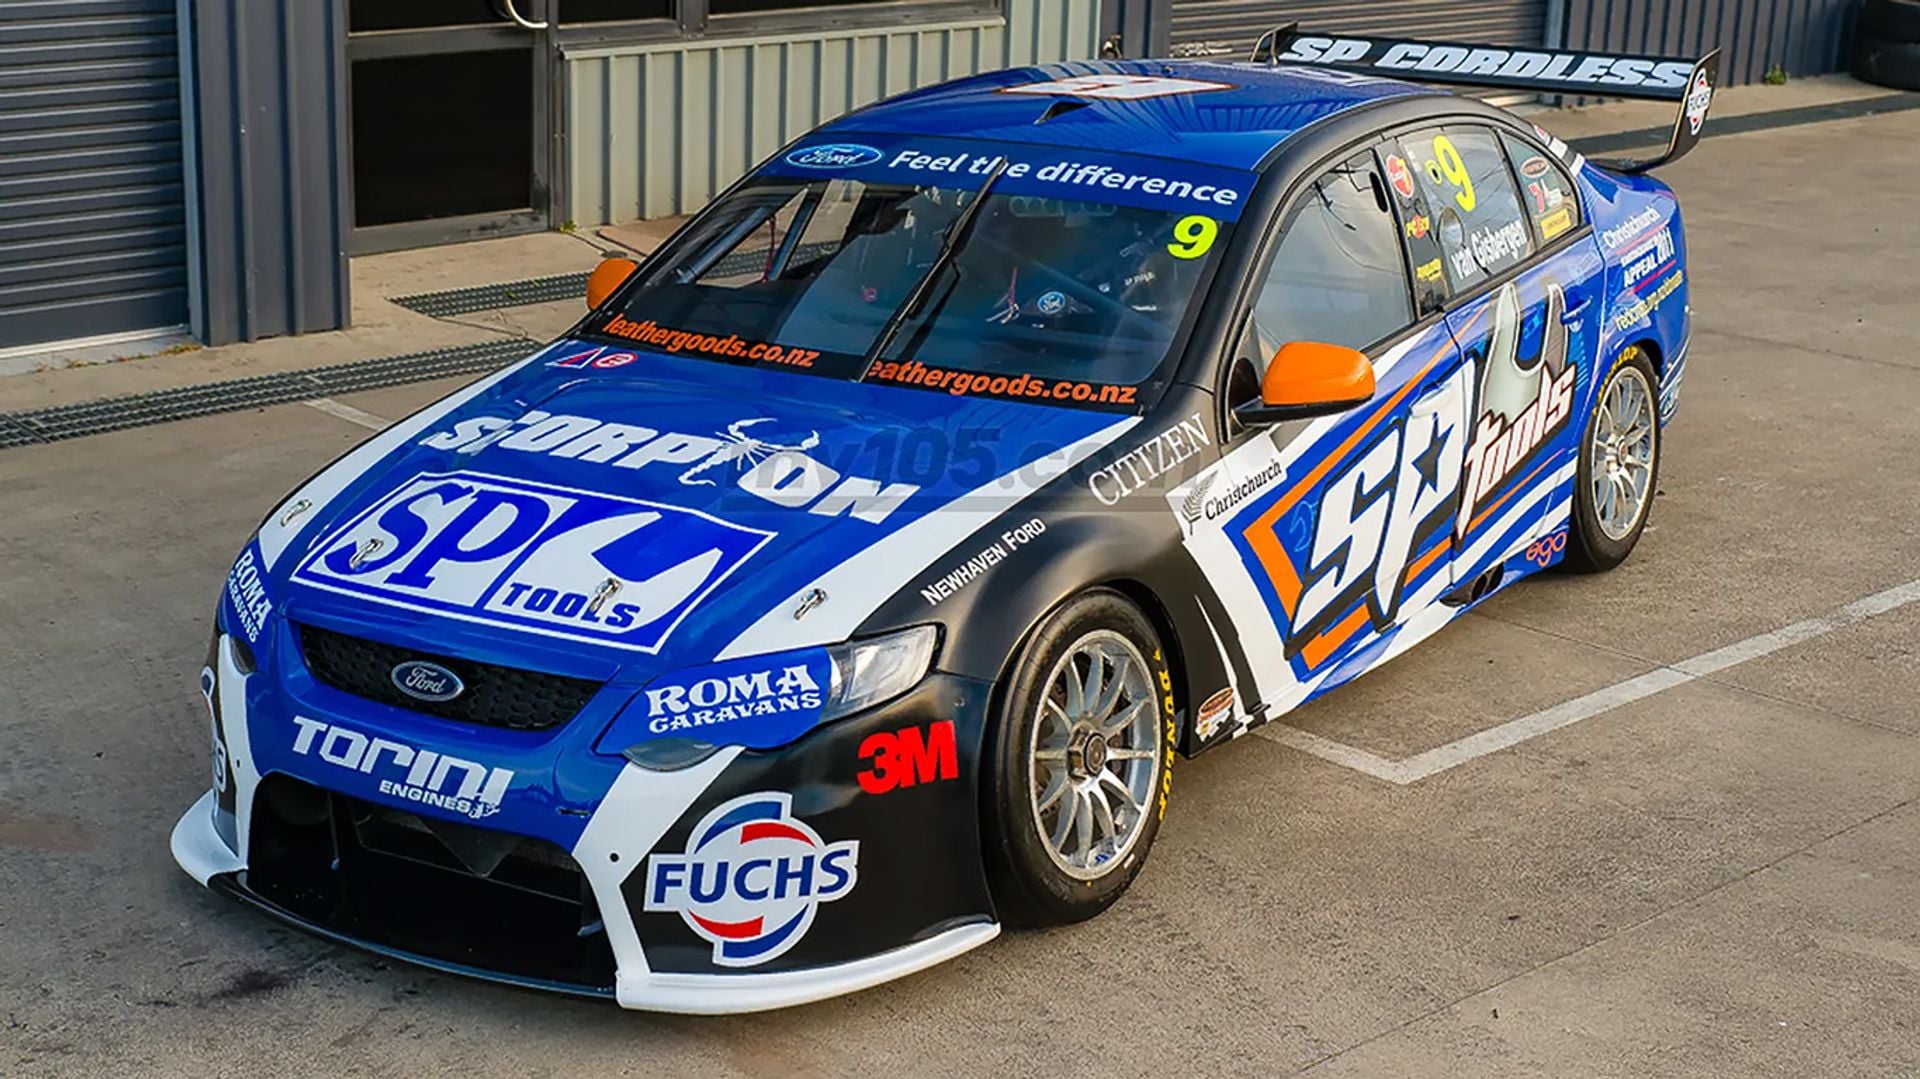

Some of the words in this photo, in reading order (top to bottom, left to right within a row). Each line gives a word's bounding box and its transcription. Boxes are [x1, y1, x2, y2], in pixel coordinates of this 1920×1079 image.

[1278, 37, 1372, 64] SP
[1374, 44, 1698, 89] CORDLESS
[888, 149, 961, 173] Feel
[1035, 161, 1239, 207] difference
[1433, 135, 1476, 212] 9
[1167, 215, 1219, 260] 9
[1450, 246, 1478, 280] van
[602, 313, 821, 369] leathergoods.co.nz
[867, 359, 1138, 405] eathergoods.co.nz
[1089, 412, 1211, 506] CITIZEN
[1204, 457, 1284, 521] Christchurch
[324, 482, 551, 590] SP
[1525, 531, 1568, 568] ego
[234, 549, 273, 631] ROMA
[405, 667, 447, 694] Ford
[645, 664, 820, 718] ROMA
[856, 720, 960, 795] 3M
[1158, 669, 1177, 821] DUNLOP
[379, 779, 472, 814] ENGINES
[652, 848, 851, 905] FUCHS
